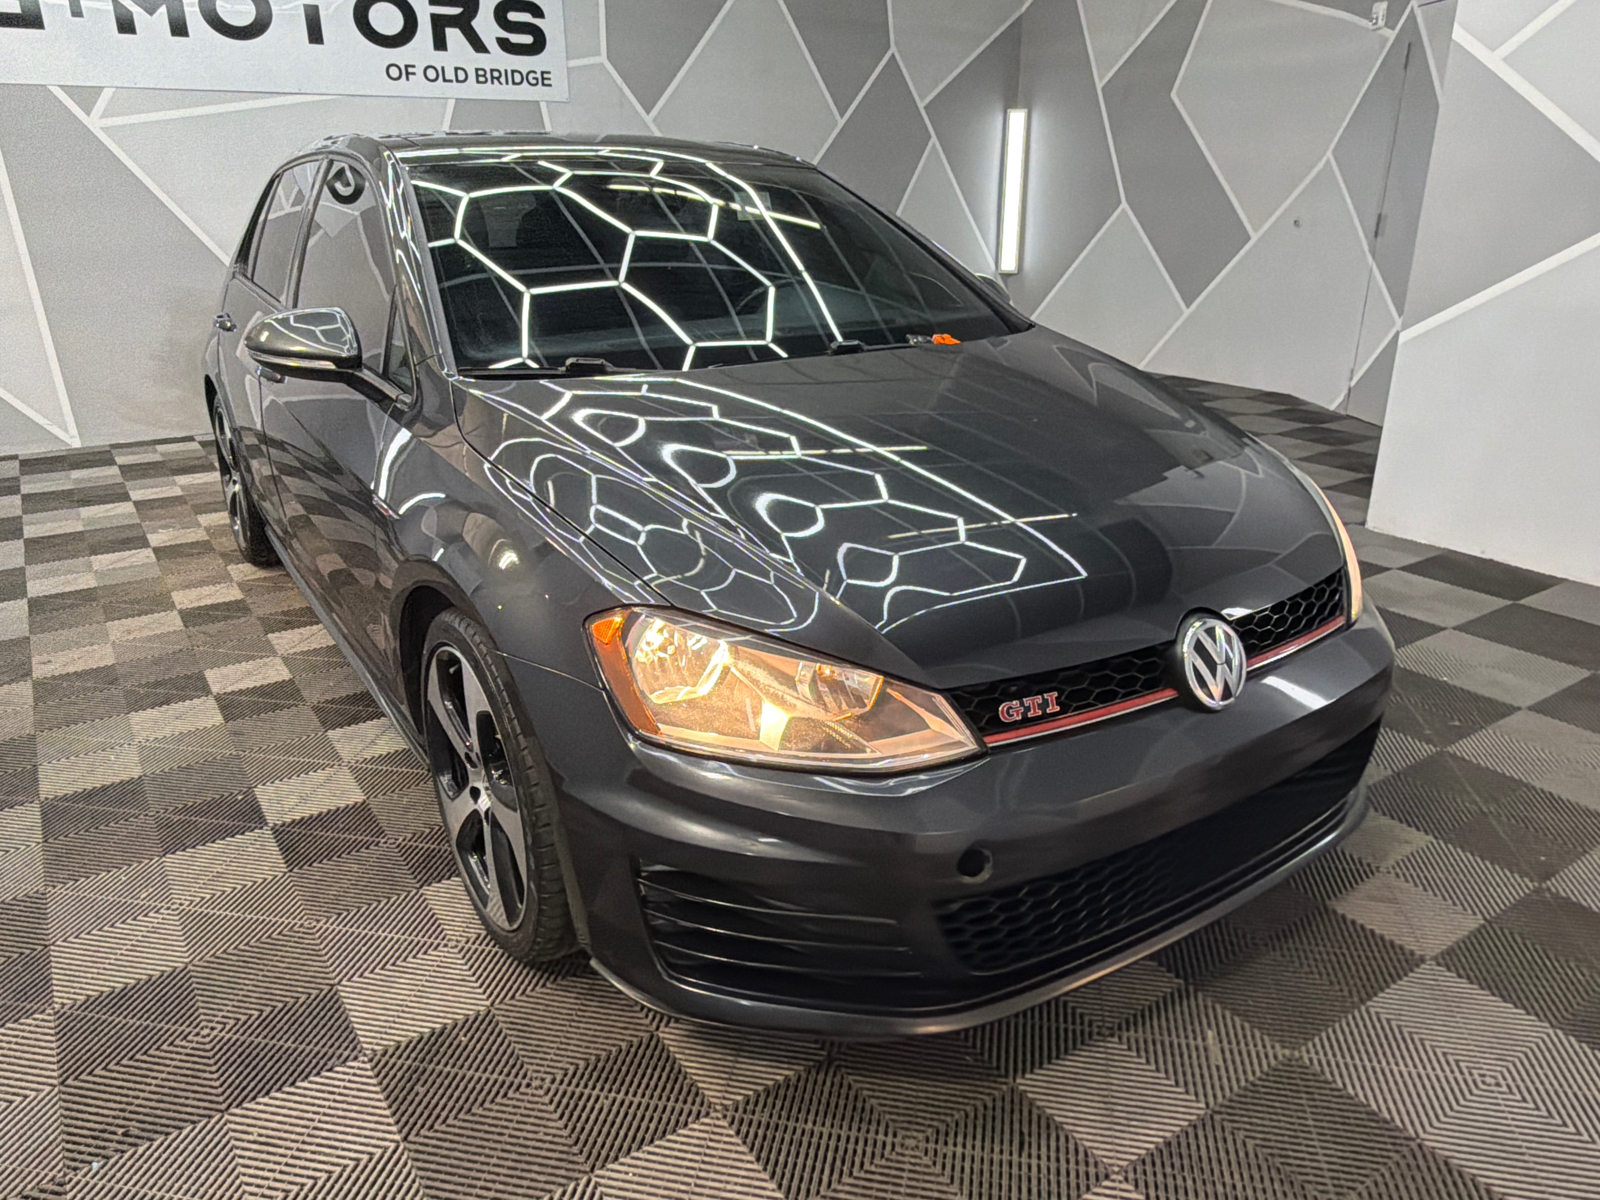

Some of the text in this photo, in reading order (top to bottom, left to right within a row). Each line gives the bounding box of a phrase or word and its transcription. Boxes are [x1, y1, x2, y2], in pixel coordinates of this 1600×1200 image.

[385, 63, 553, 88] OF OLD BRIDGE
[998, 691, 1061, 723] GTI
